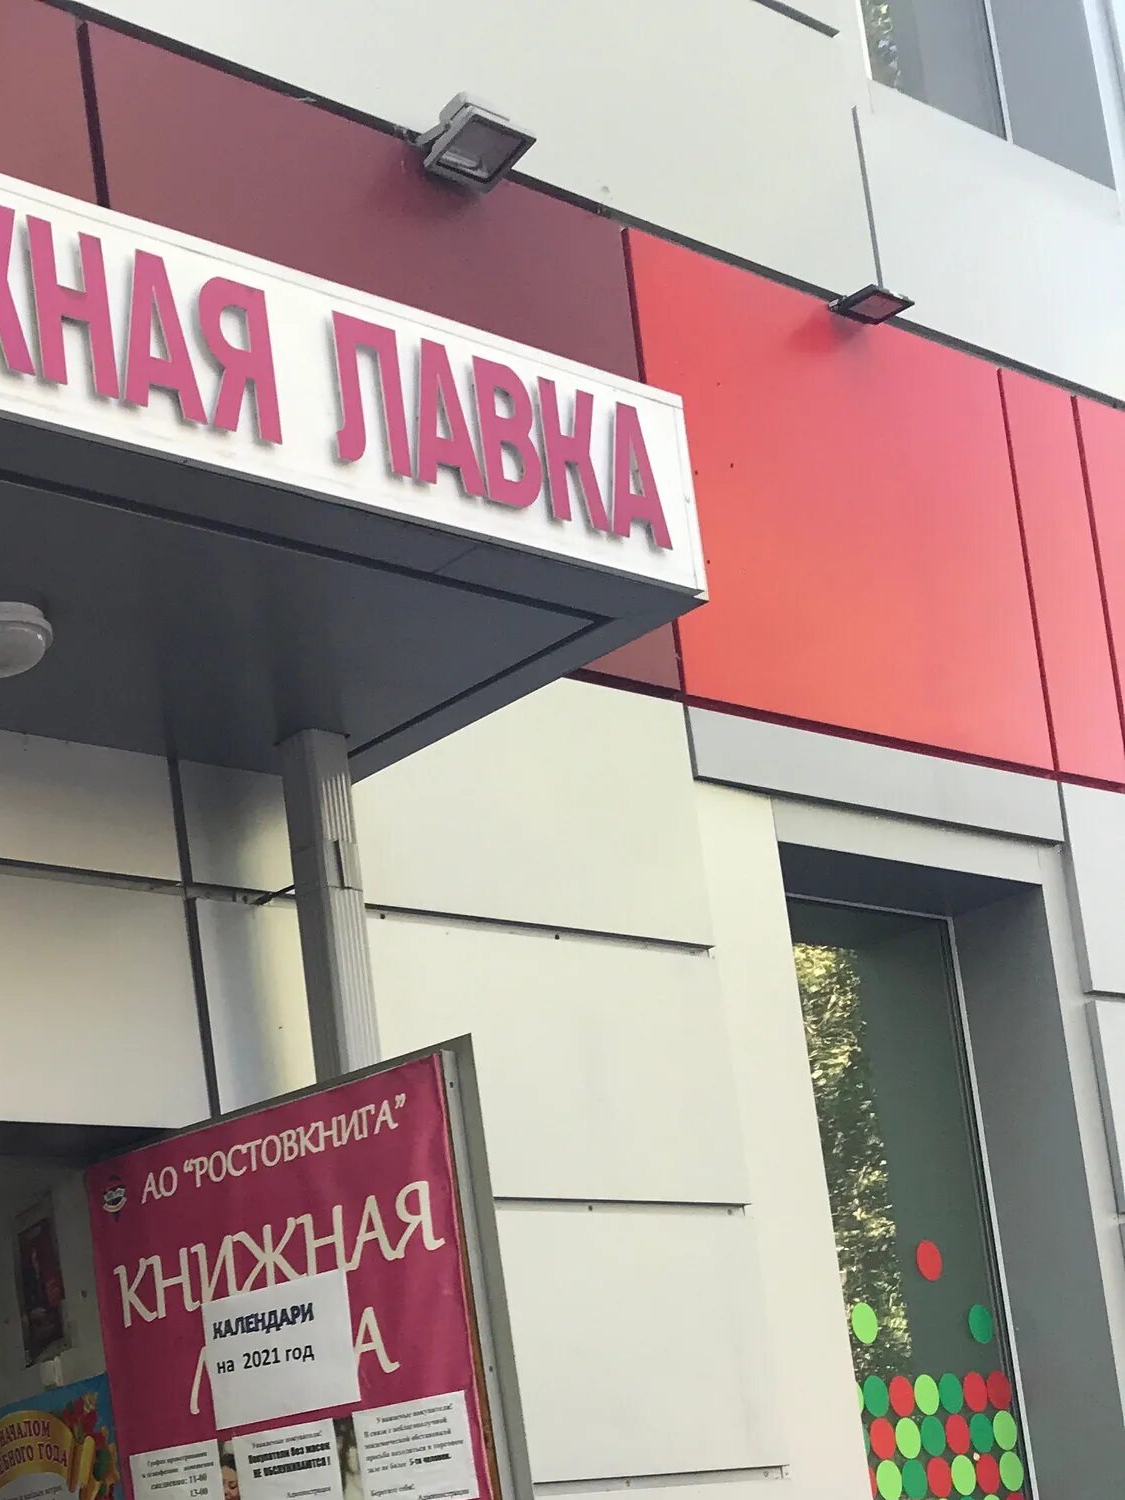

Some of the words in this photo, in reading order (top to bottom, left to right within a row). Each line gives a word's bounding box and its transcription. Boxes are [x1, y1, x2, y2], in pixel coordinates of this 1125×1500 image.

[331, 310, 673, 551] ЛАВКА
[141, 1166, 179, 1204] АО
[114, 1181, 446, 1328] КНИЖНАЯ
[212, 1303, 315, 1340] КАЛЕНДАРИ
[217, 1358, 236, 1375] на
[243, 1346, 281, 1370] 2021
[285, 1344, 315, 1364] год
[0, 1419, 51, 1442] НАЧАЛОМ
[38, 1443, 69, 1468] ГОДА
